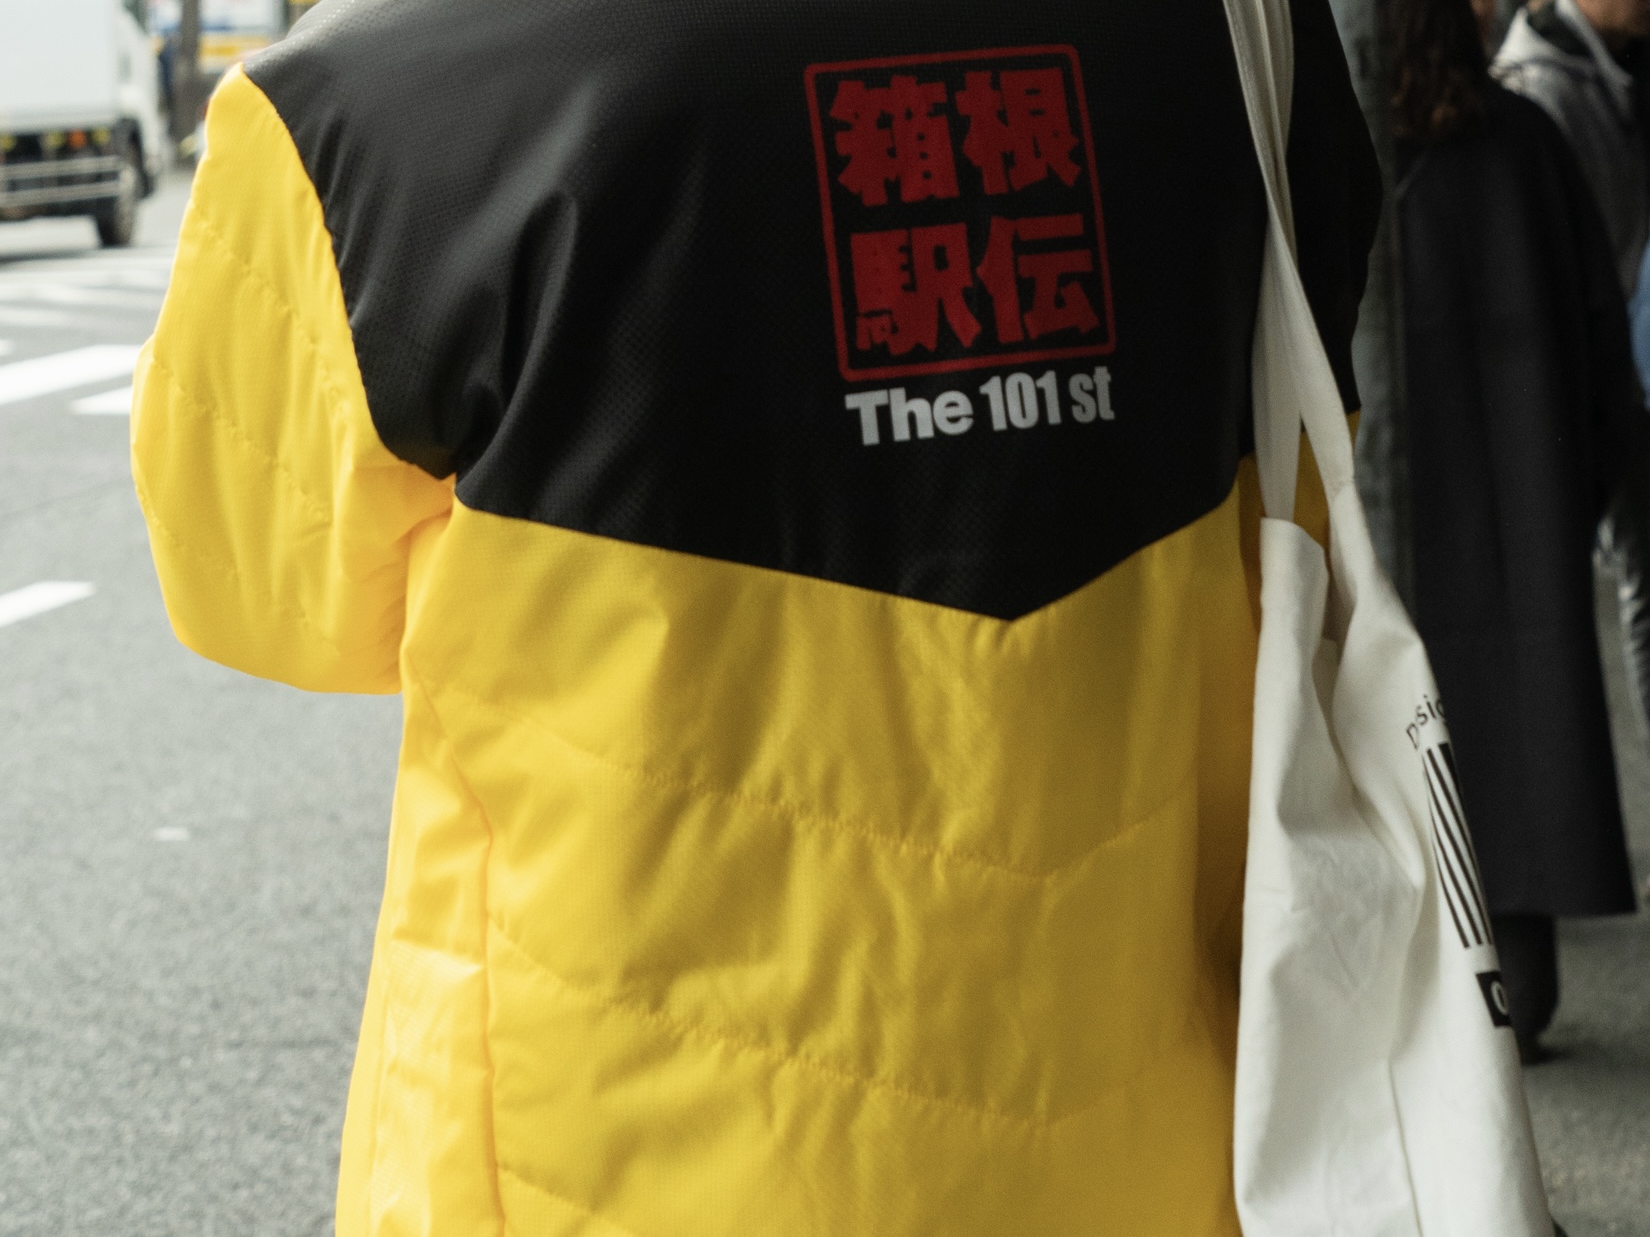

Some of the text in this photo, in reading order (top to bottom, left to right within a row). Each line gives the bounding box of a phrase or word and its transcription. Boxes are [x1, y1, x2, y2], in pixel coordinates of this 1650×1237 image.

[830, 67, 1082, 207] 箱根
[850, 213, 1100, 356] 駅伝
[845, 366, 1116, 446] The 101 st
